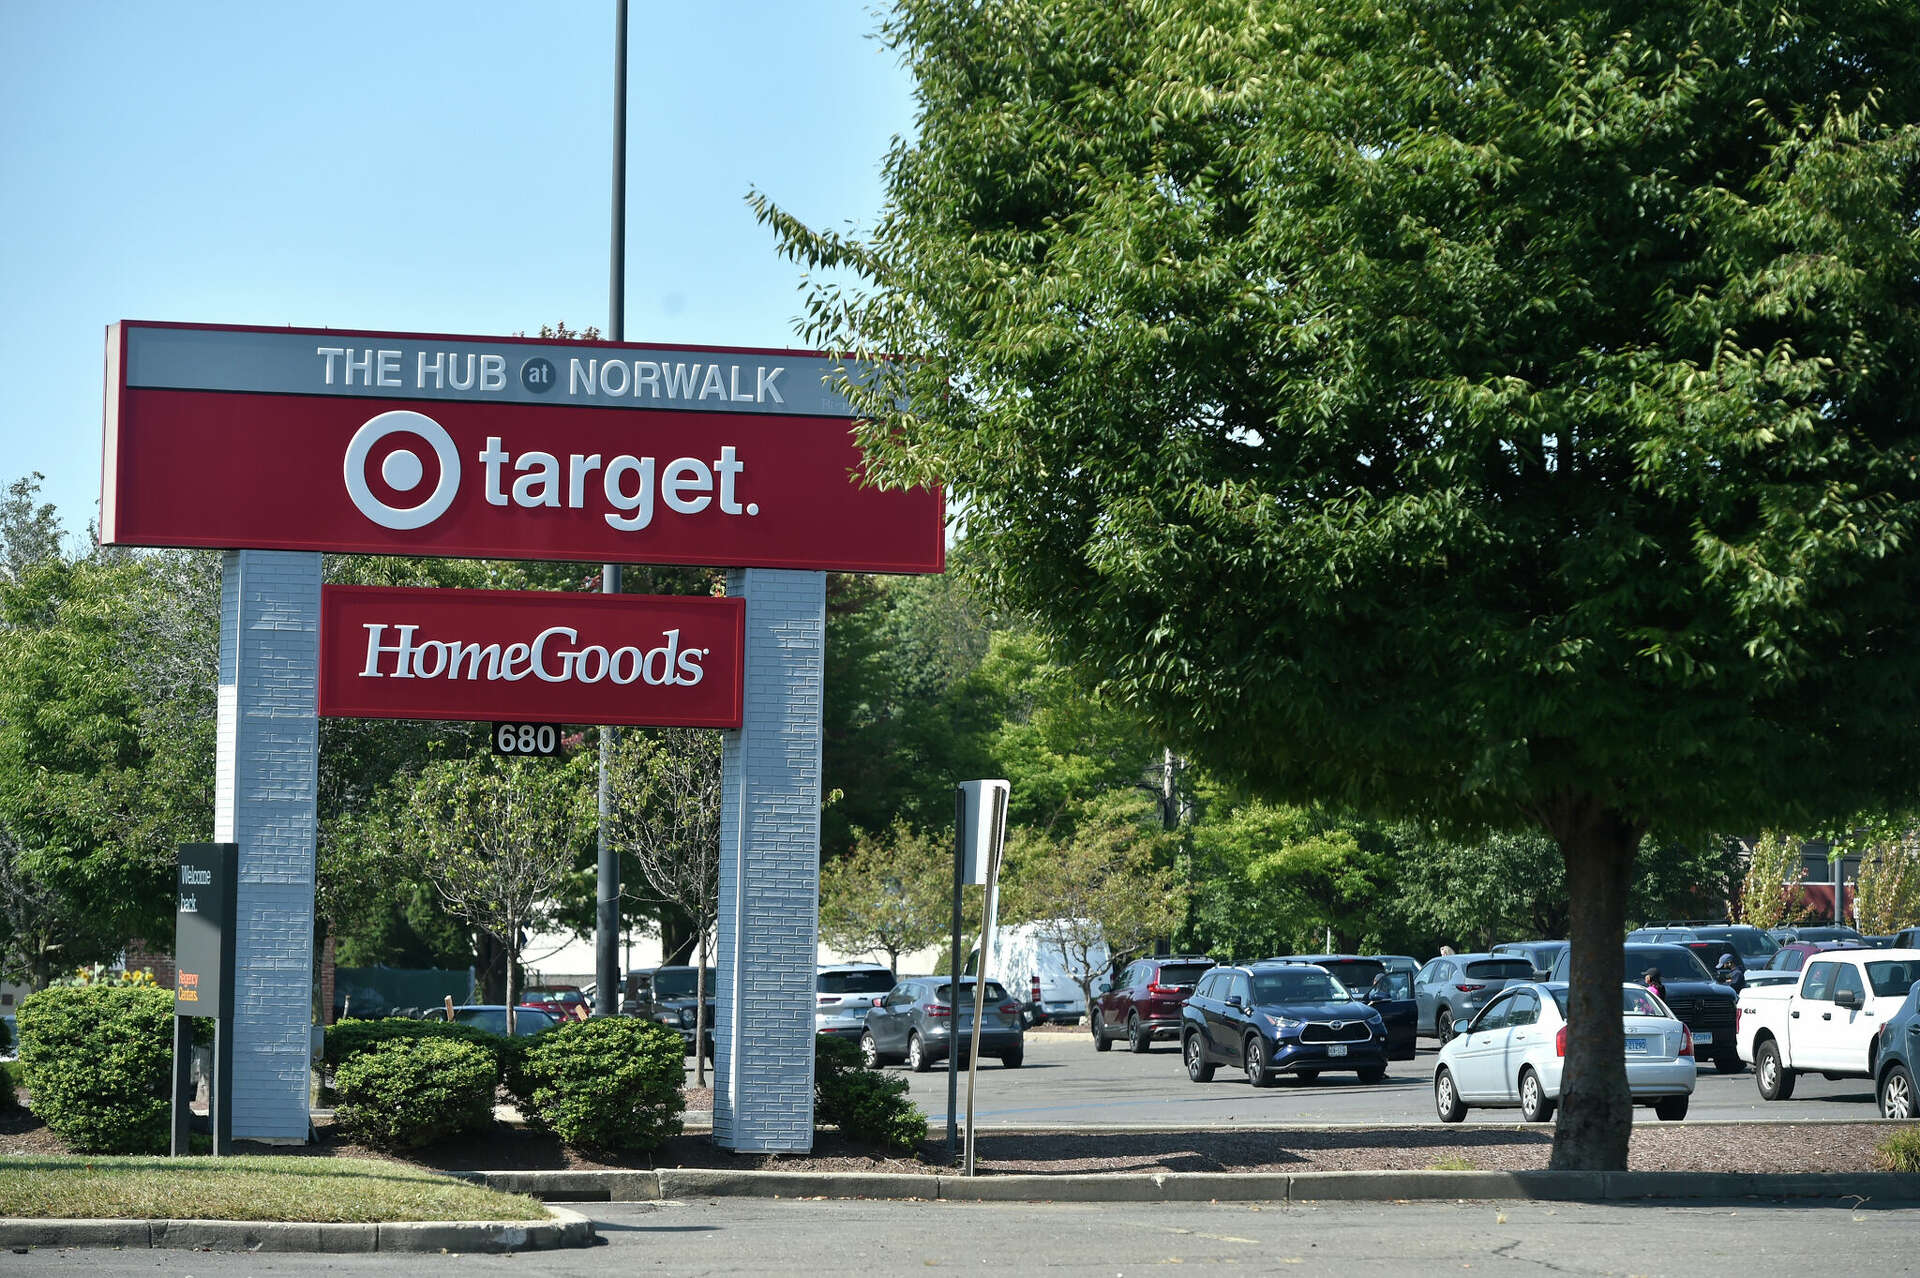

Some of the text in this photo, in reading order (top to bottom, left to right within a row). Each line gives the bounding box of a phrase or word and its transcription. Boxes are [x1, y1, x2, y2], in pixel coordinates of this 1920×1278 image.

[317, 347, 785, 403] THE HUB at NORWALK
[358, 623, 709, 686] HomeGoods
[497, 724, 556, 754] 680
[181, 864, 211, 885] Welcome
